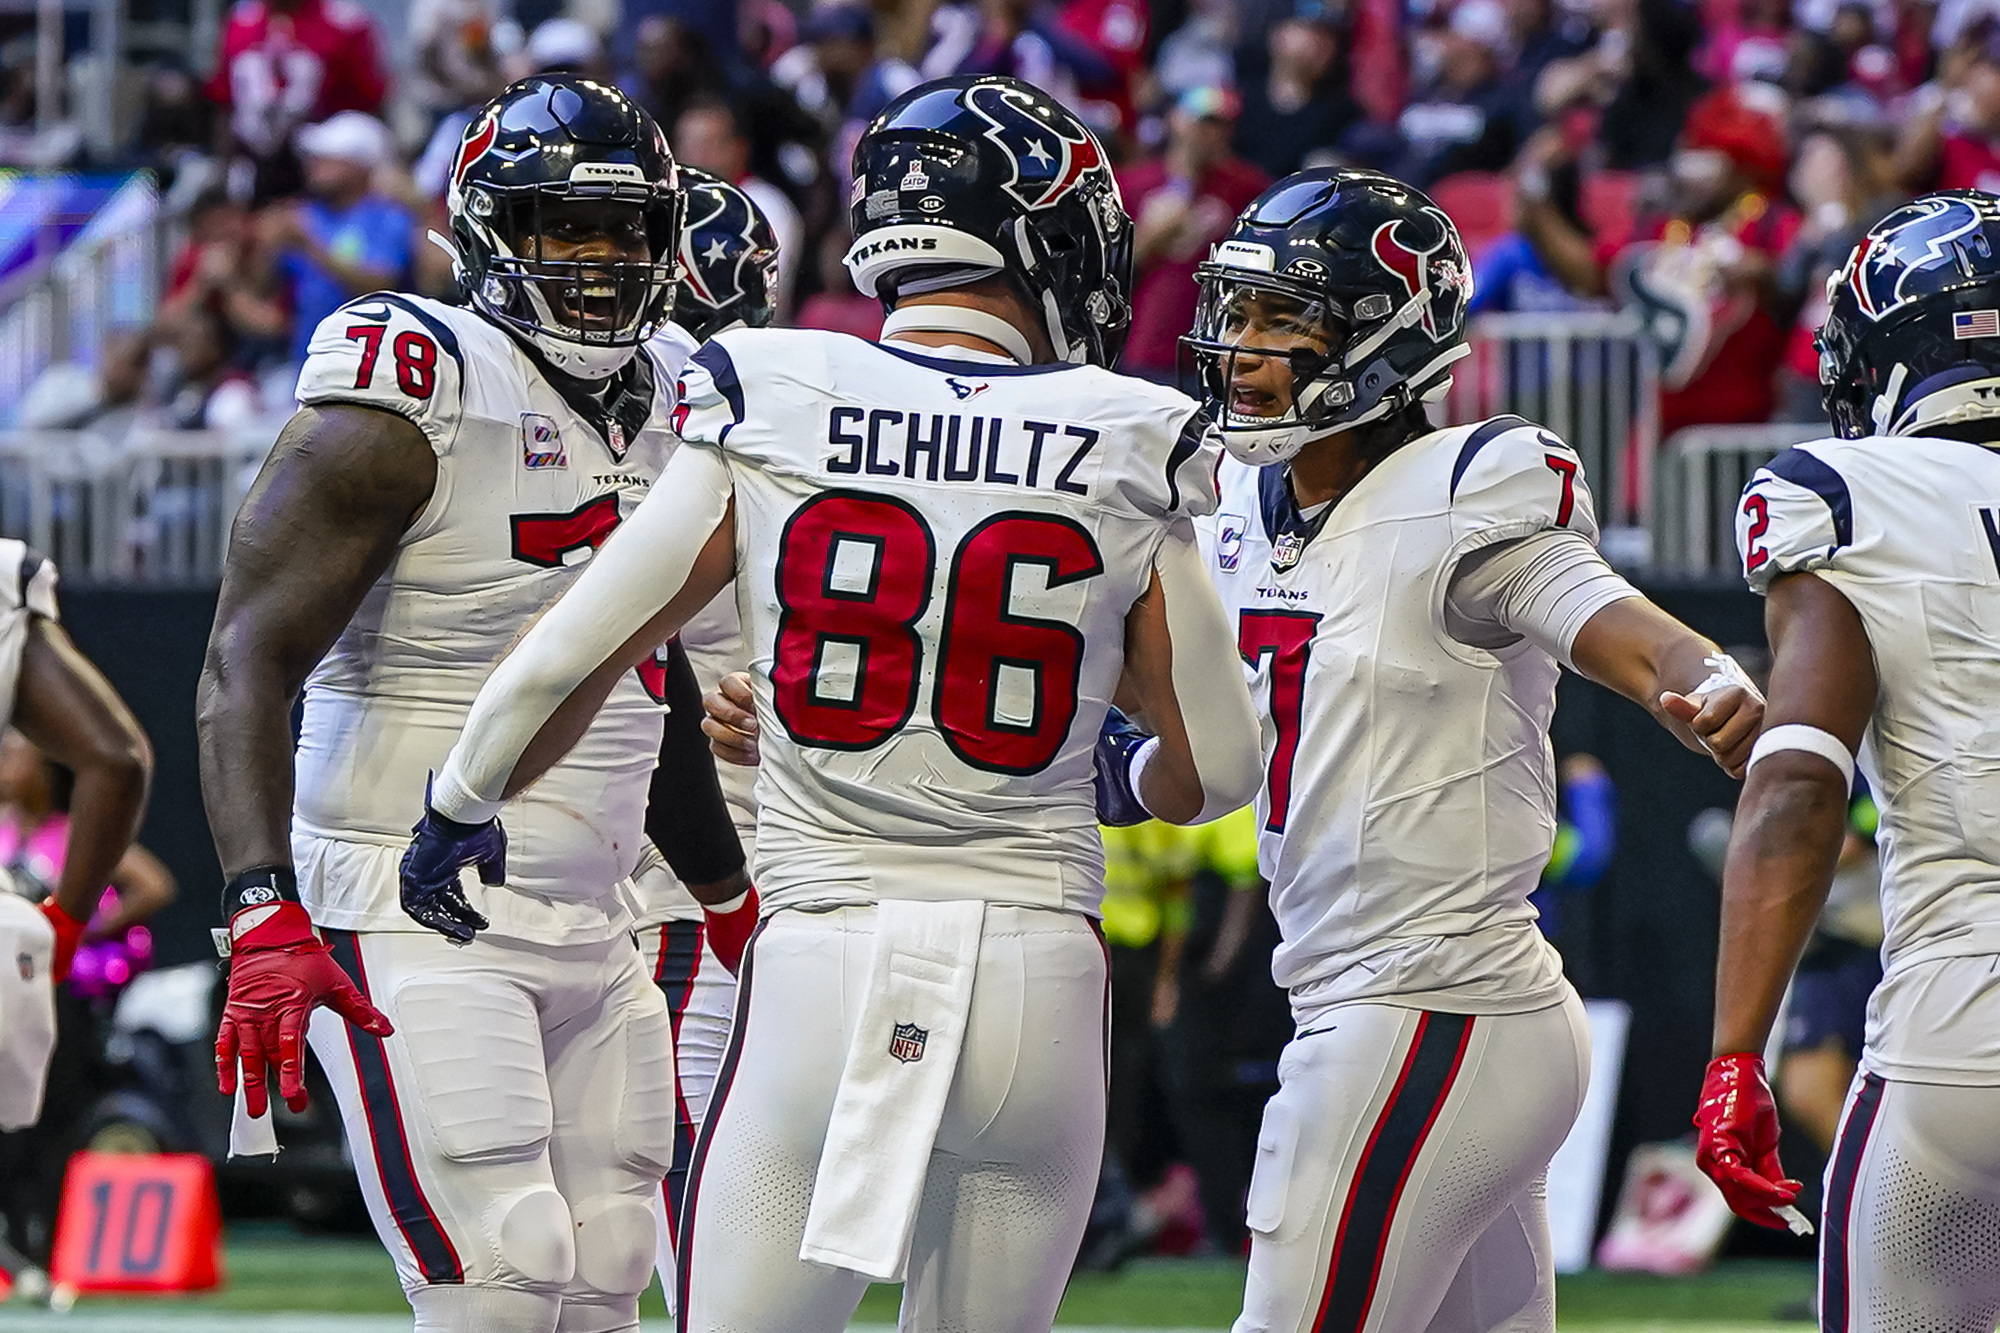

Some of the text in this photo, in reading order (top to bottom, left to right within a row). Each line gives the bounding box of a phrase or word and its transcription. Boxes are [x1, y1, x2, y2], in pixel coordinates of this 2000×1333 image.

[851, 237, 938, 267] TEXANS
[345, 324, 438, 400] 78
[592, 474, 650, 488] TEXANS
[826, 406, 1100, 497] SCHULTZ
[1544, 453, 1577, 529] 7
[1275, 546, 1297, 562] NFL
[1743, 493, 1770, 575] 2
[769, 487, 1105, 777] 86
[1238, 607, 1324, 836] 7
[893, 1037, 921, 1059] NFL
[88, 1179, 174, 1274] 10
